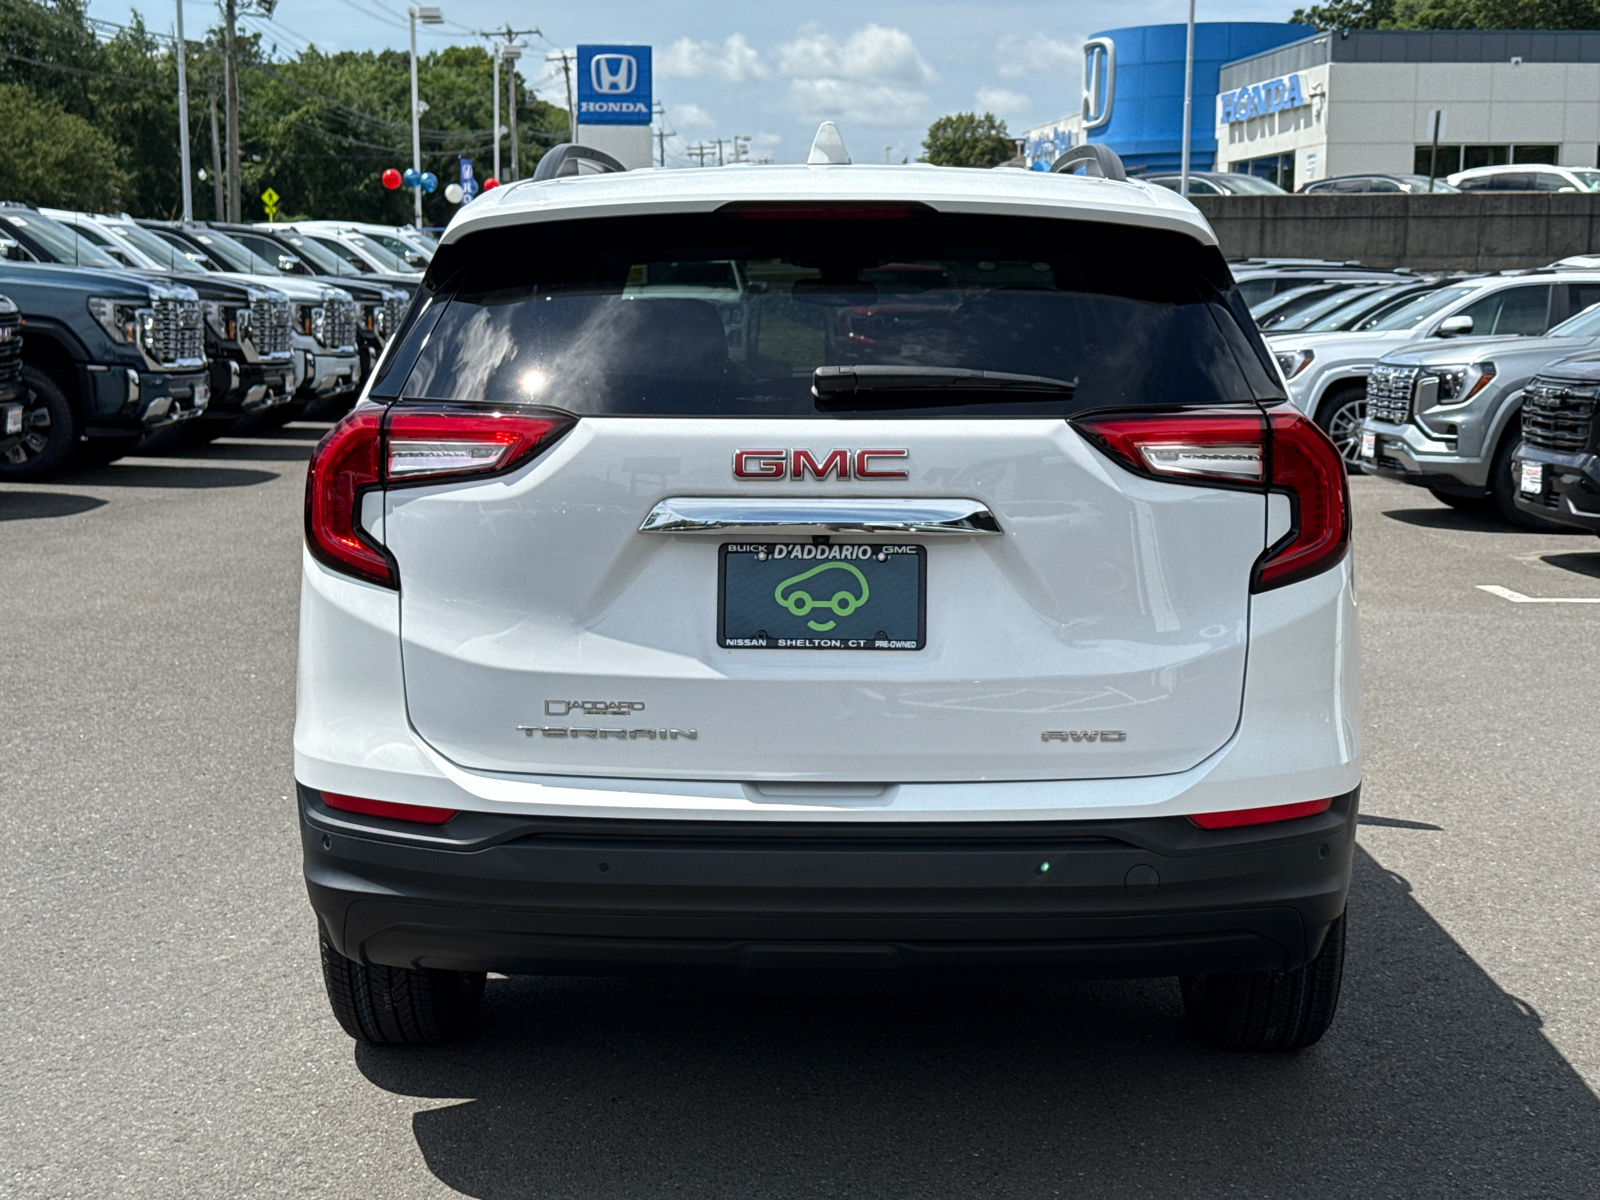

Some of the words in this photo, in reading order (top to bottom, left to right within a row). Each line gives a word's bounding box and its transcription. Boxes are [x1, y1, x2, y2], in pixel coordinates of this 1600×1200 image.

[579, 102, 649, 113] HONDA
[1220, 74, 1304, 125] HONDA
[732, 448, 909, 481] GMC
[773, 544, 872, 560] D'ADDARIO
[882, 545, 917, 554] GMC
[725, 639, 767, 647] NISSAN
[777, 639, 844, 648] SHELTON,
[848, 639, 867, 647] CT
[875, 640, 917, 649] PRE-OWNED
[544, 700, 646, 716] D'ADDARIO
[516, 725, 698, 741] TERRAIN
[1041, 730, 1127, 742] AWD
